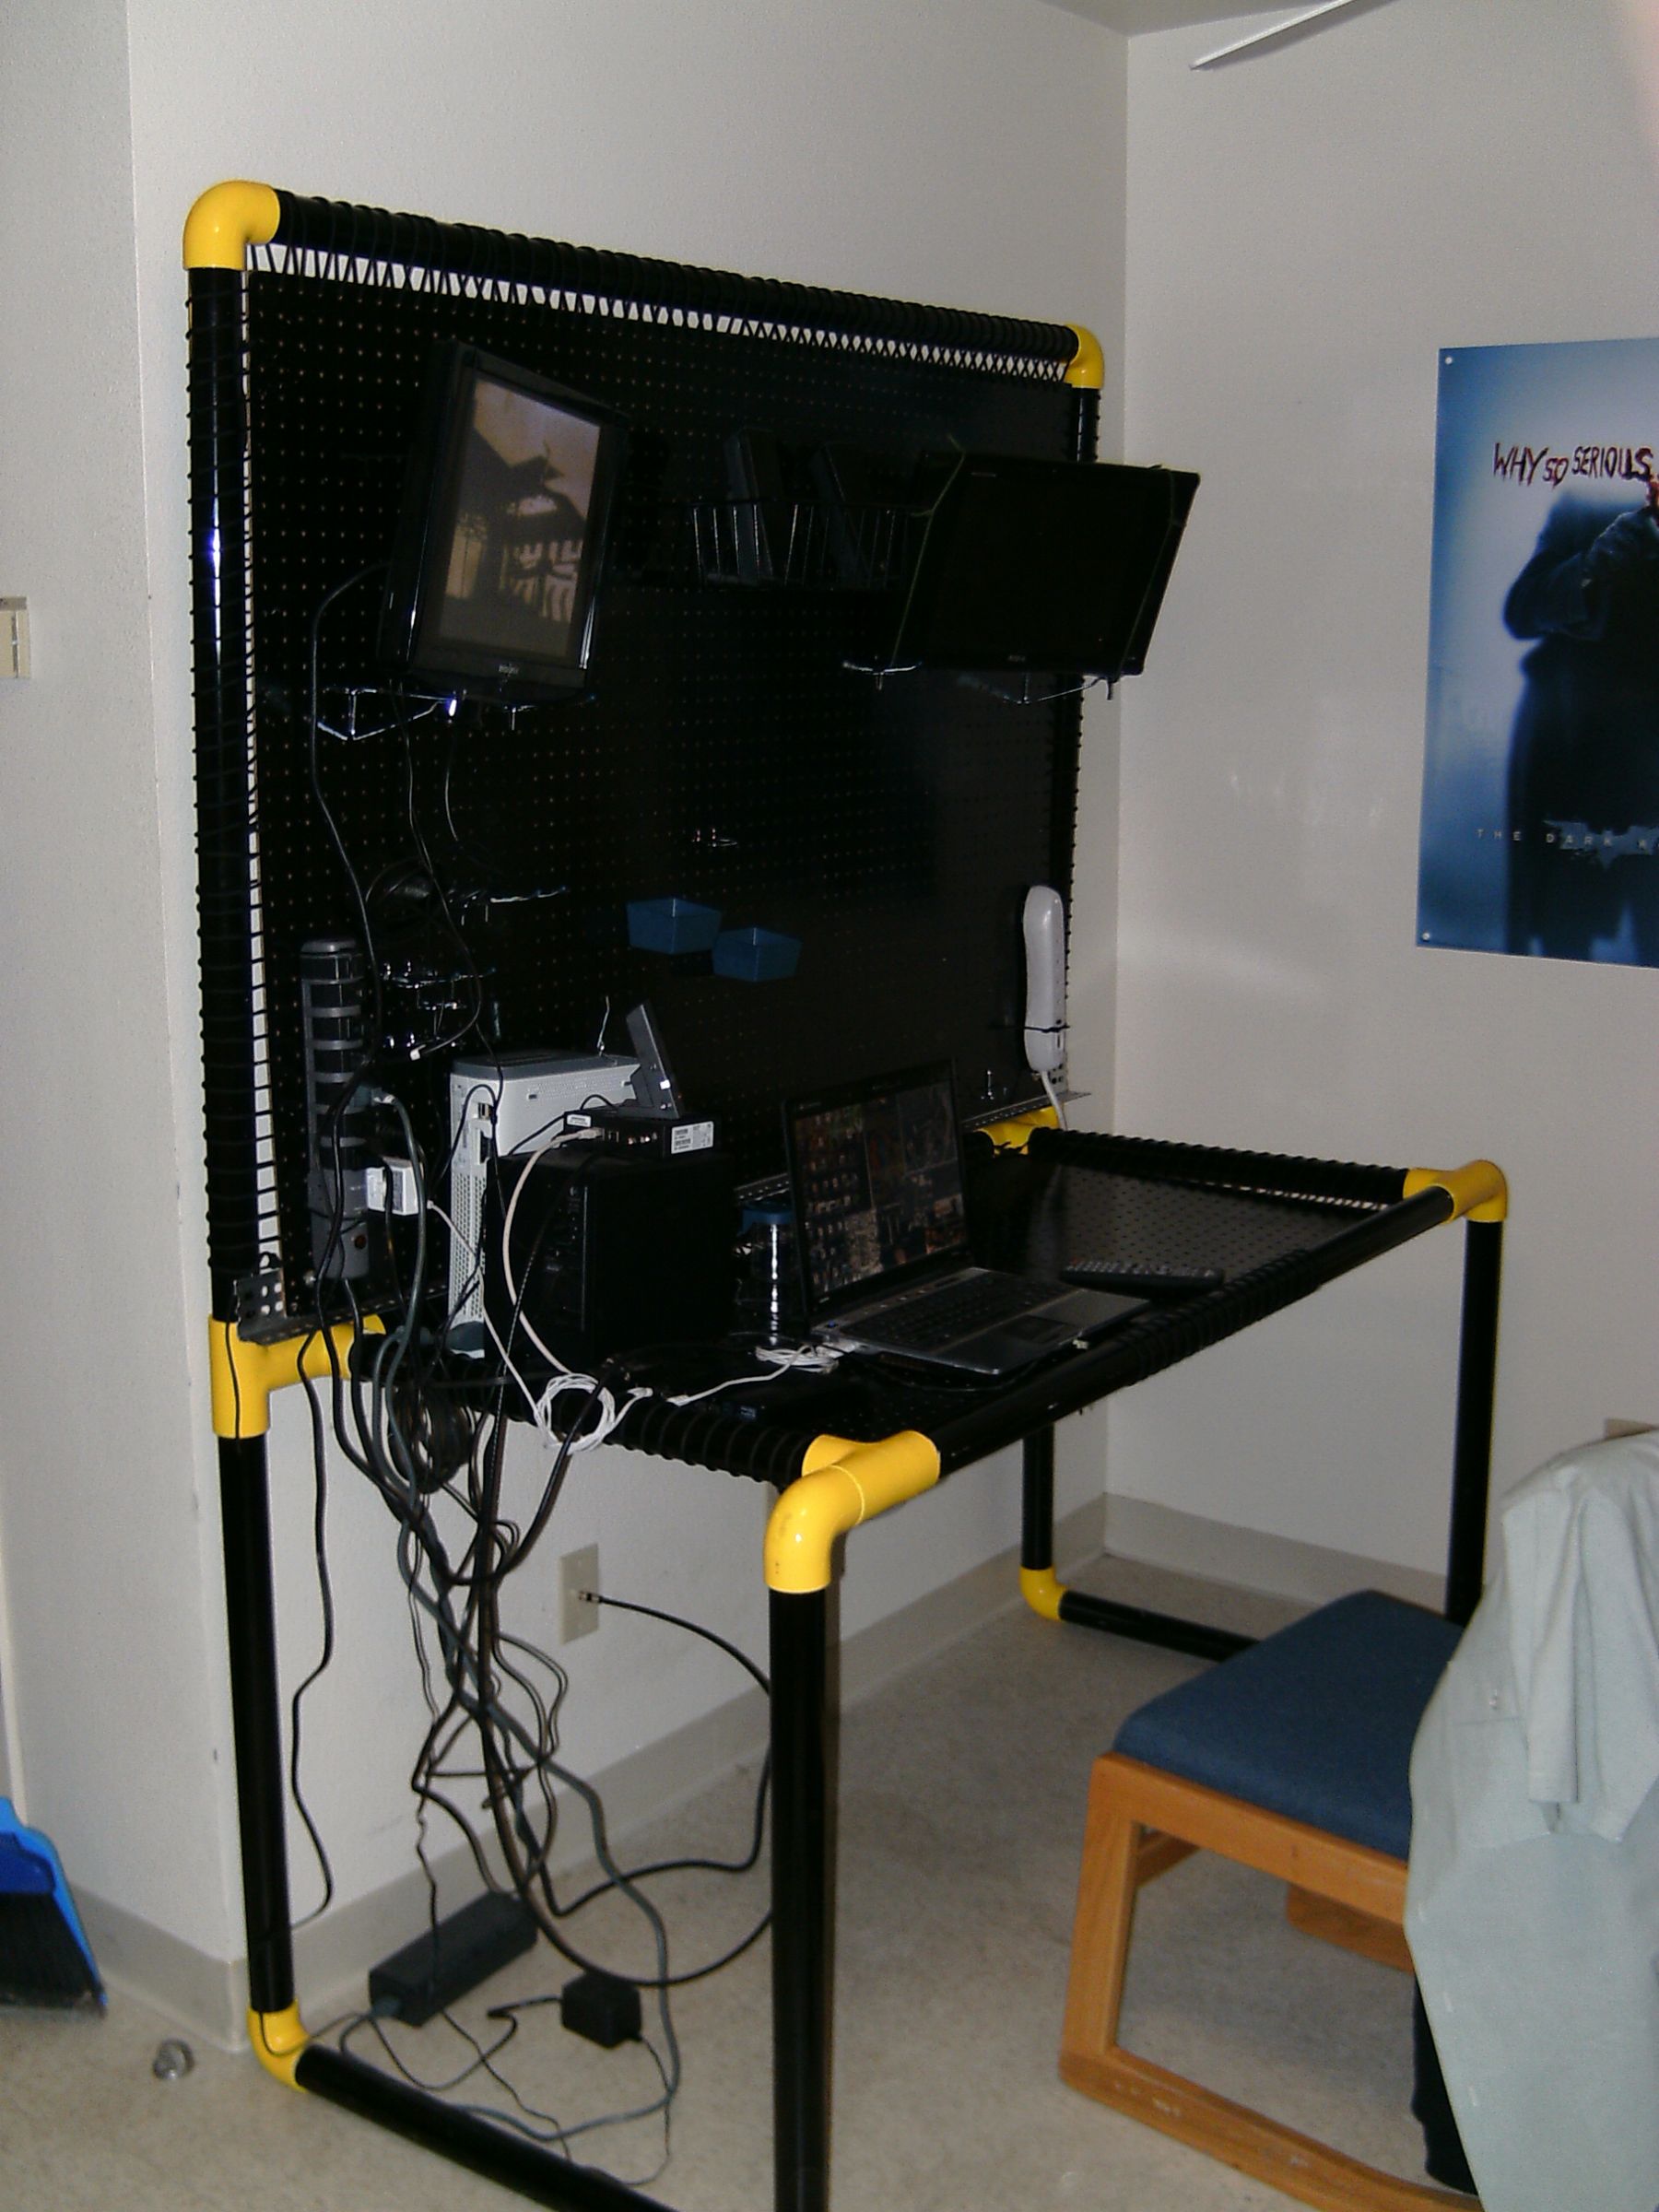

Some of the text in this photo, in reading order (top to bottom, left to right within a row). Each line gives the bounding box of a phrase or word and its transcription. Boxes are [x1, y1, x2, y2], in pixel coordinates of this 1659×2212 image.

[1492, 441, 1654, 489] WHY SO SERIOUS
[1477, 829, 1613, 846] THE DARK
